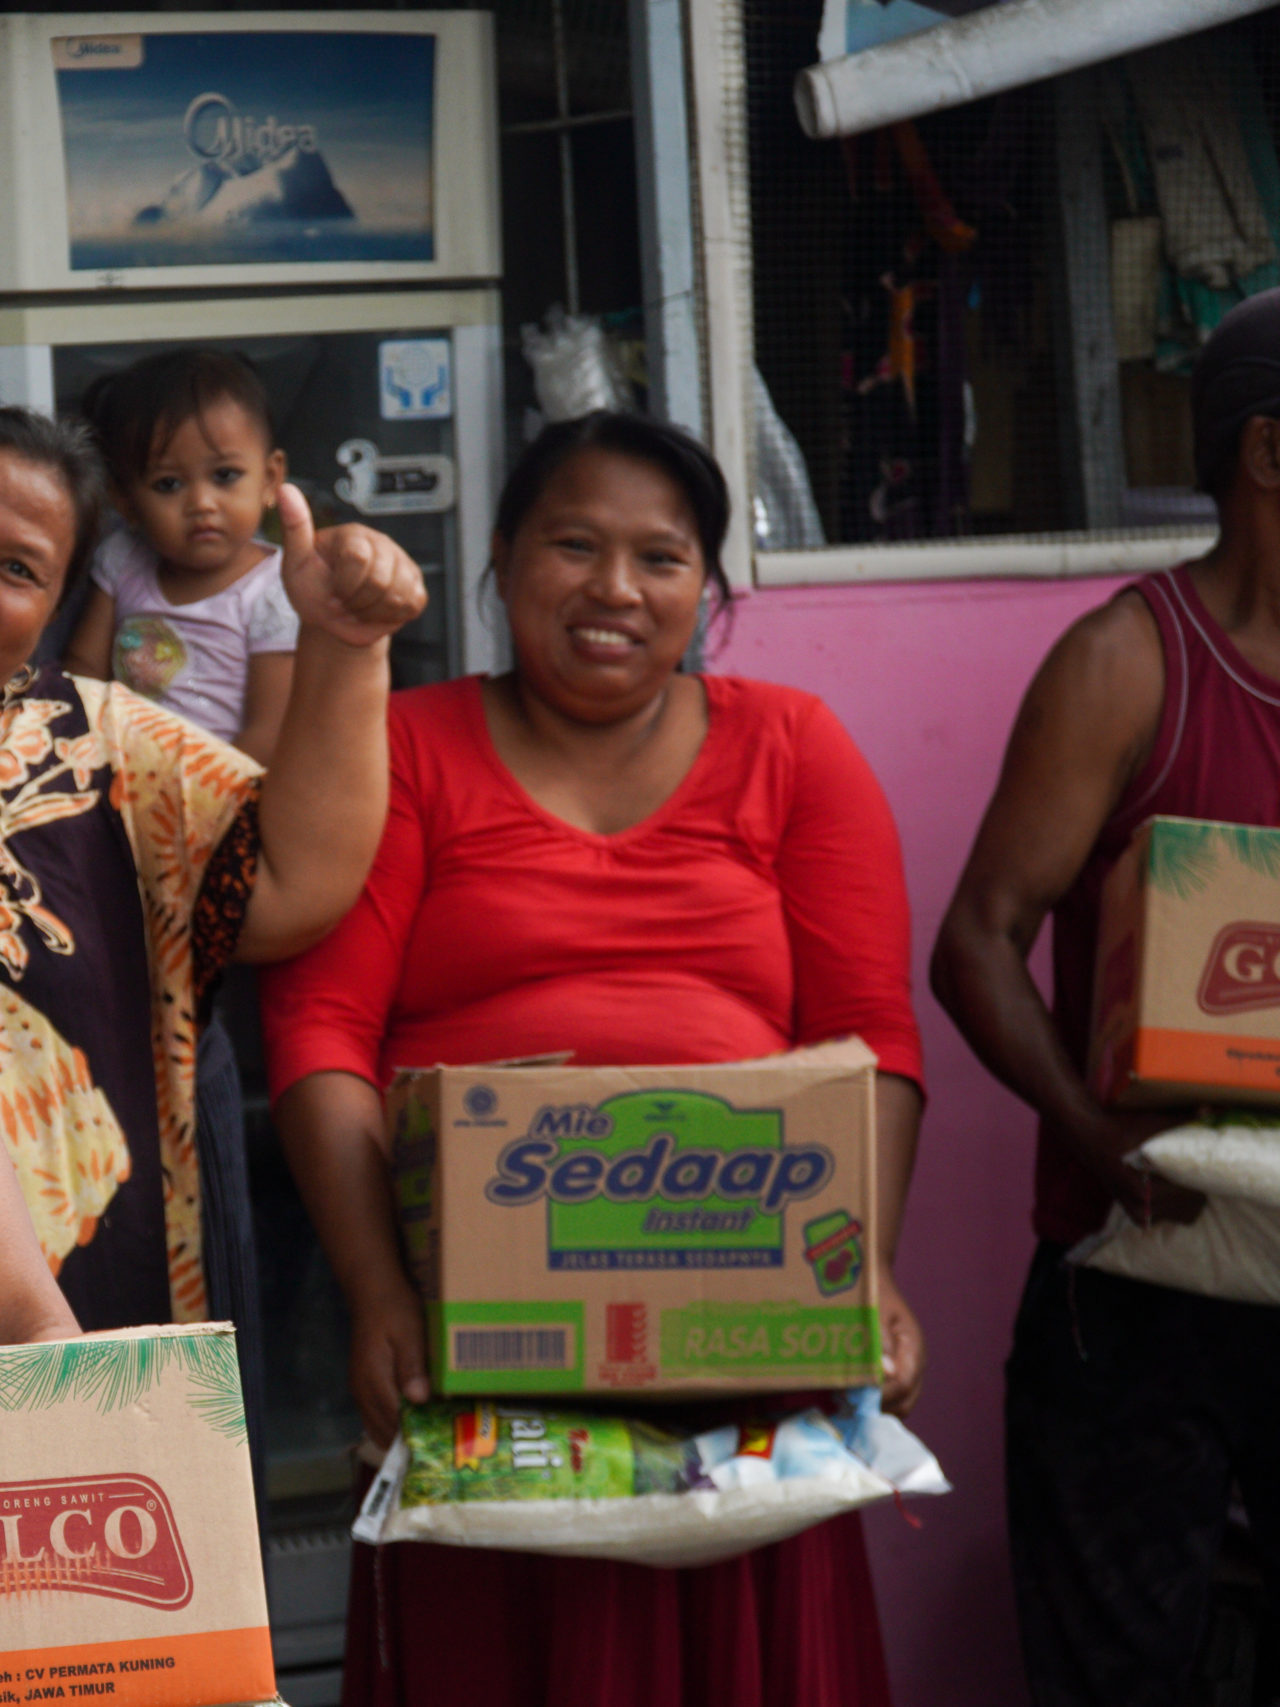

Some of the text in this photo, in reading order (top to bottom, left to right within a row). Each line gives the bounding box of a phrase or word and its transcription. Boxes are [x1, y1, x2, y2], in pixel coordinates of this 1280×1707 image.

[66, 37, 121, 58] Midea
[184, 92, 317, 159] Midea
[1223, 943, 1280, 983] G
[532, 1107, 612, 1138] Mie
[488, 1135, 831, 1210] Sedaap
[643, 1206, 756, 1234] Instant
[685, 1326, 771, 1358] RASA
[60, 1493, 106, 1506] SAWIT
[25, 1668, 46, 1681] CV
[49, 1662, 116, 1679] PERMATA
[119, 1656, 176, 1672] KUNING
[24, 1685, 66, 1701] JAWA
[68, 1681, 116, 1697] TIMUR
